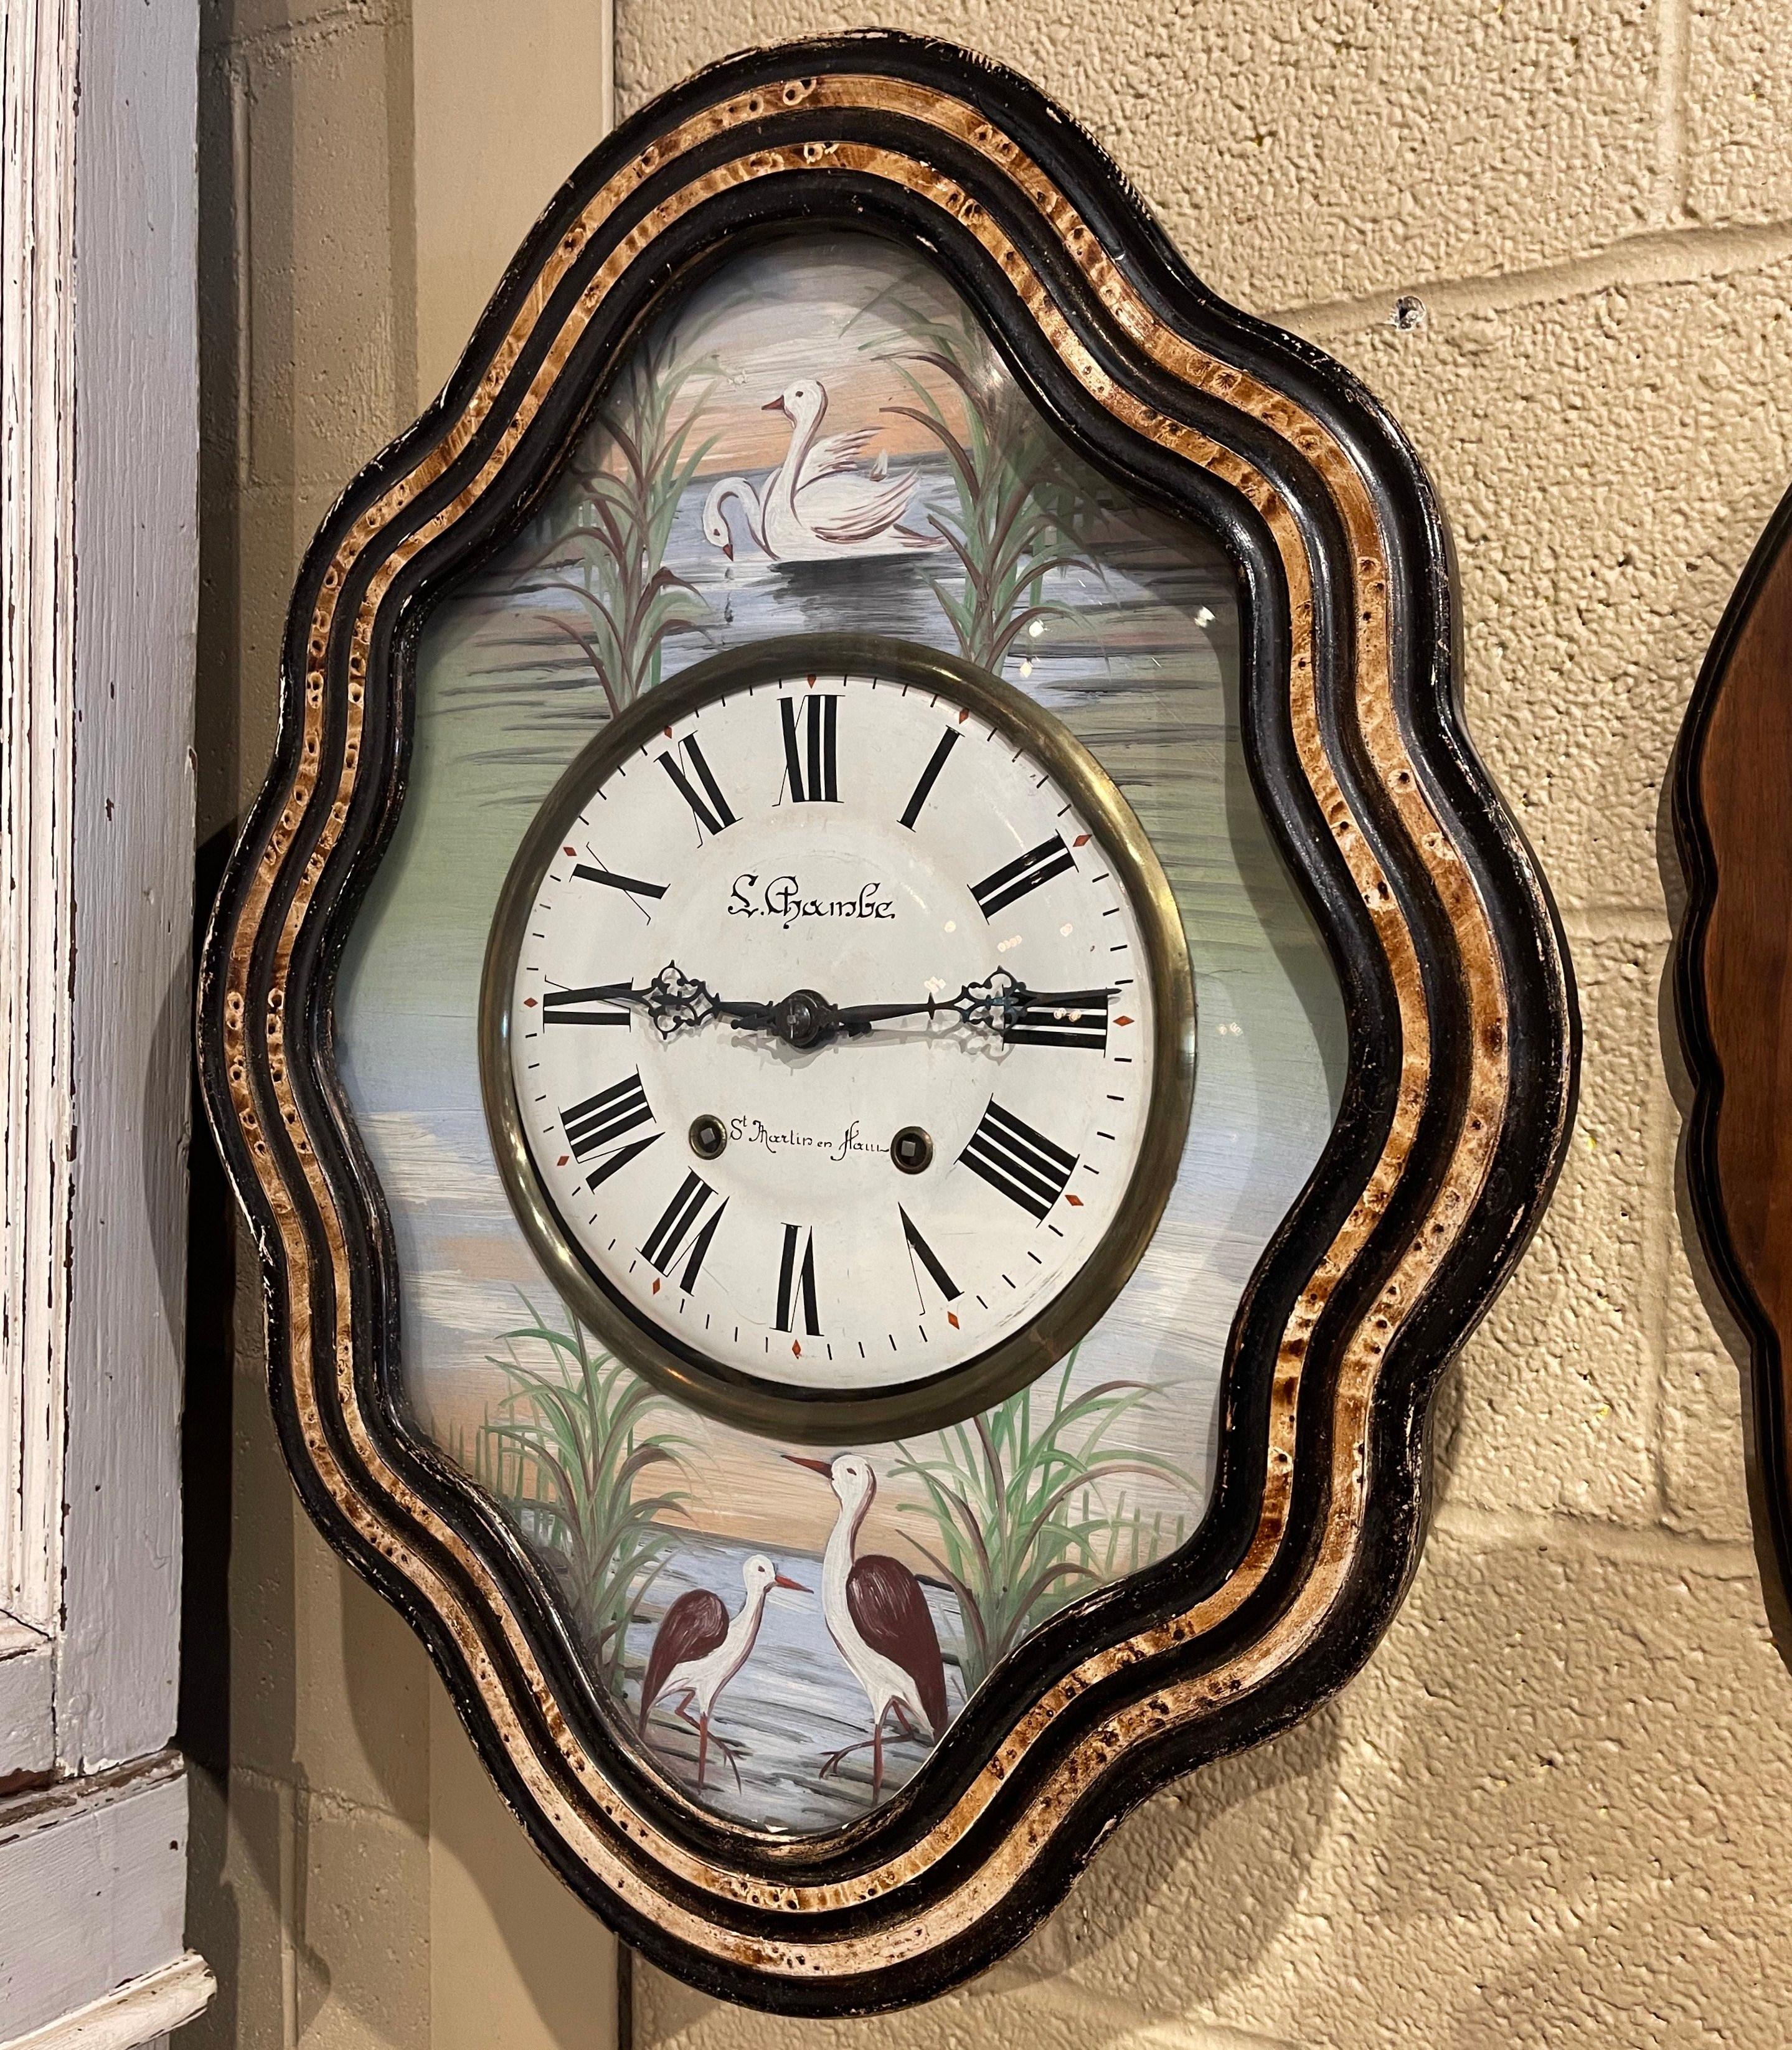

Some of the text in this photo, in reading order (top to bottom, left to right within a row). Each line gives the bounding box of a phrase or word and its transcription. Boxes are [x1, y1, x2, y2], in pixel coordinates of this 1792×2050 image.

[654, 730, 743, 849] XI
[771, 694, 846, 807] XII
[897, 724, 965, 833] I
[569, 842, 671, 926] X
[967, 829, 1079, 925] II
[559, 1064, 666, 1194] VIII
[953, 1093, 1080, 1229] IIII
[636, 1166, 730, 1297] VII
[770, 1222, 825, 1338] VI
[897, 1201, 965, 1317] V
